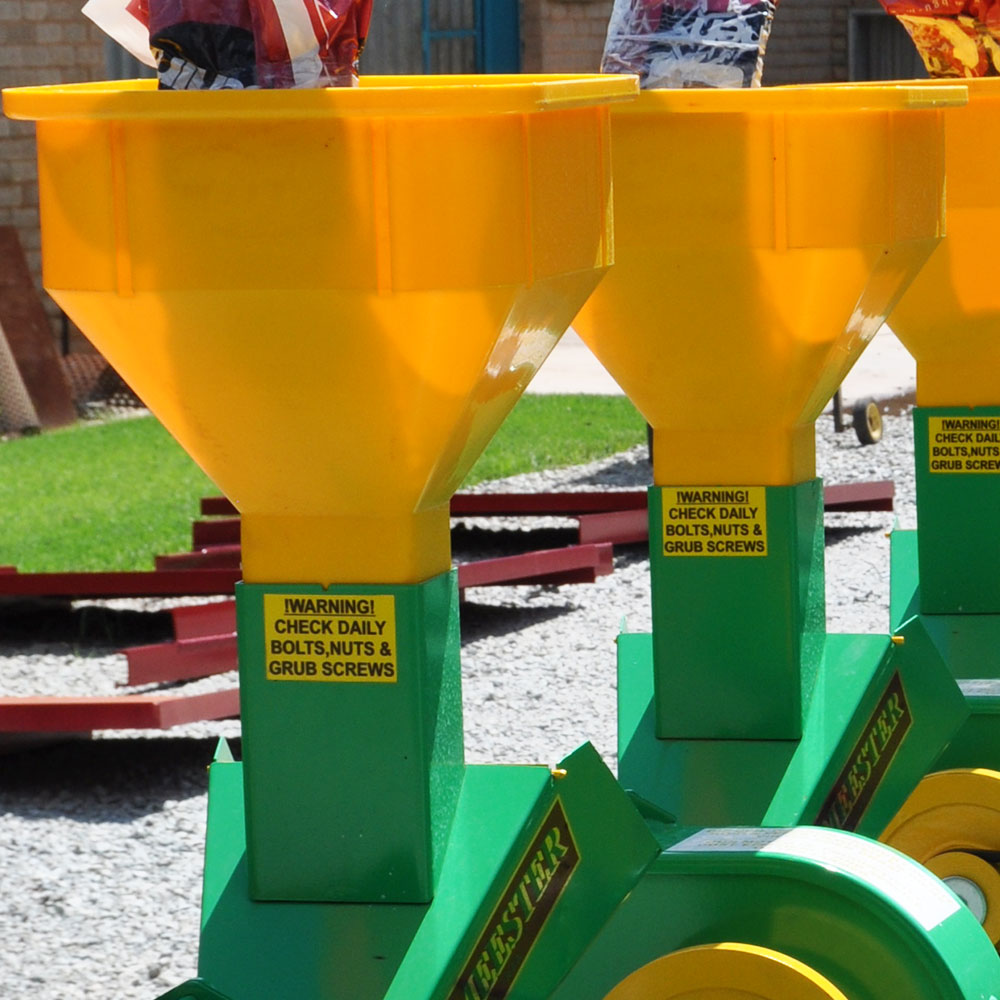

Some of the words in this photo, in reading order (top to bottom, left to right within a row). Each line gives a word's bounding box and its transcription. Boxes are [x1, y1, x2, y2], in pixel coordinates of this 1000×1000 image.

[936, 433, 972, 443] CHECK
[932, 460, 962, 470] GRUB
[669, 507, 716, 520] CHECK
[720, 507, 758, 520] DAILY
[753, 524, 762, 536] &
[664, 540, 703, 553] GRUB
[706, 540, 765, 553] SCREWS
[274, 619, 334, 634] CHECK
[338, 620, 386, 635] DAILY
[380, 641, 392, 656] &
[269, 660, 317, 676] GRUB
[322, 661, 395, 677] SCREWS
